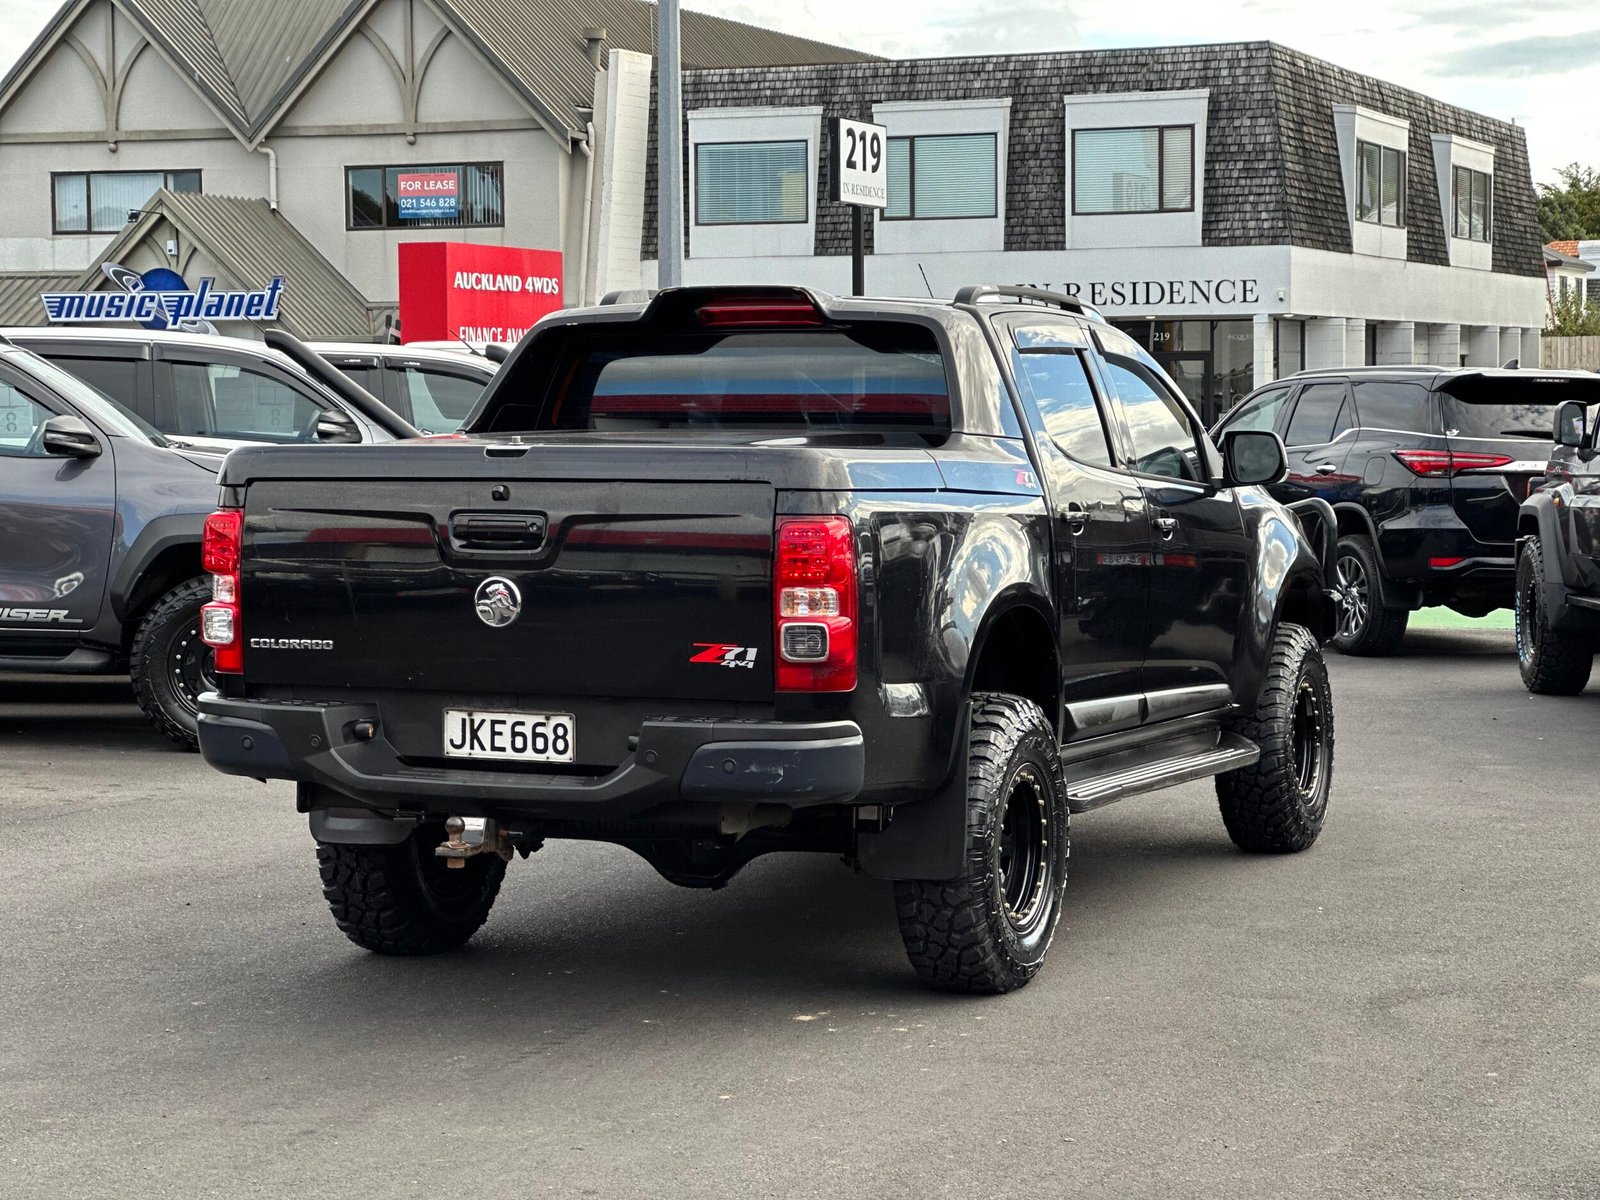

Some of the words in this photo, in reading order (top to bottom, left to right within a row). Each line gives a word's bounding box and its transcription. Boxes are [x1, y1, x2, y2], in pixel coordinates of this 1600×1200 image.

[846, 127, 881, 174] 219
[400, 181, 421, 190] FOR
[423, 180, 455, 190] LEASE
[842, 182, 850, 194] IN
[851, 183, 885, 200] RESIDENCE
[400, 199, 417, 208] 021
[420, 198, 436, 207] 546
[438, 198, 456, 207] 828
[454, 271, 522, 293] AUCKLAND
[525, 276, 559, 295] 4WDS
[1063, 279, 1260, 306] RESIDENCE
[40, 278, 158, 321] music
[159, 275, 286, 330] planet
[459, 326, 503, 342] FINANCE
[1153, 332, 1171, 341] 219
[250, 638, 334, 650] COLORADO
[689, 642, 758, 663] Z71
[449, 717, 570, 755] JKE668
